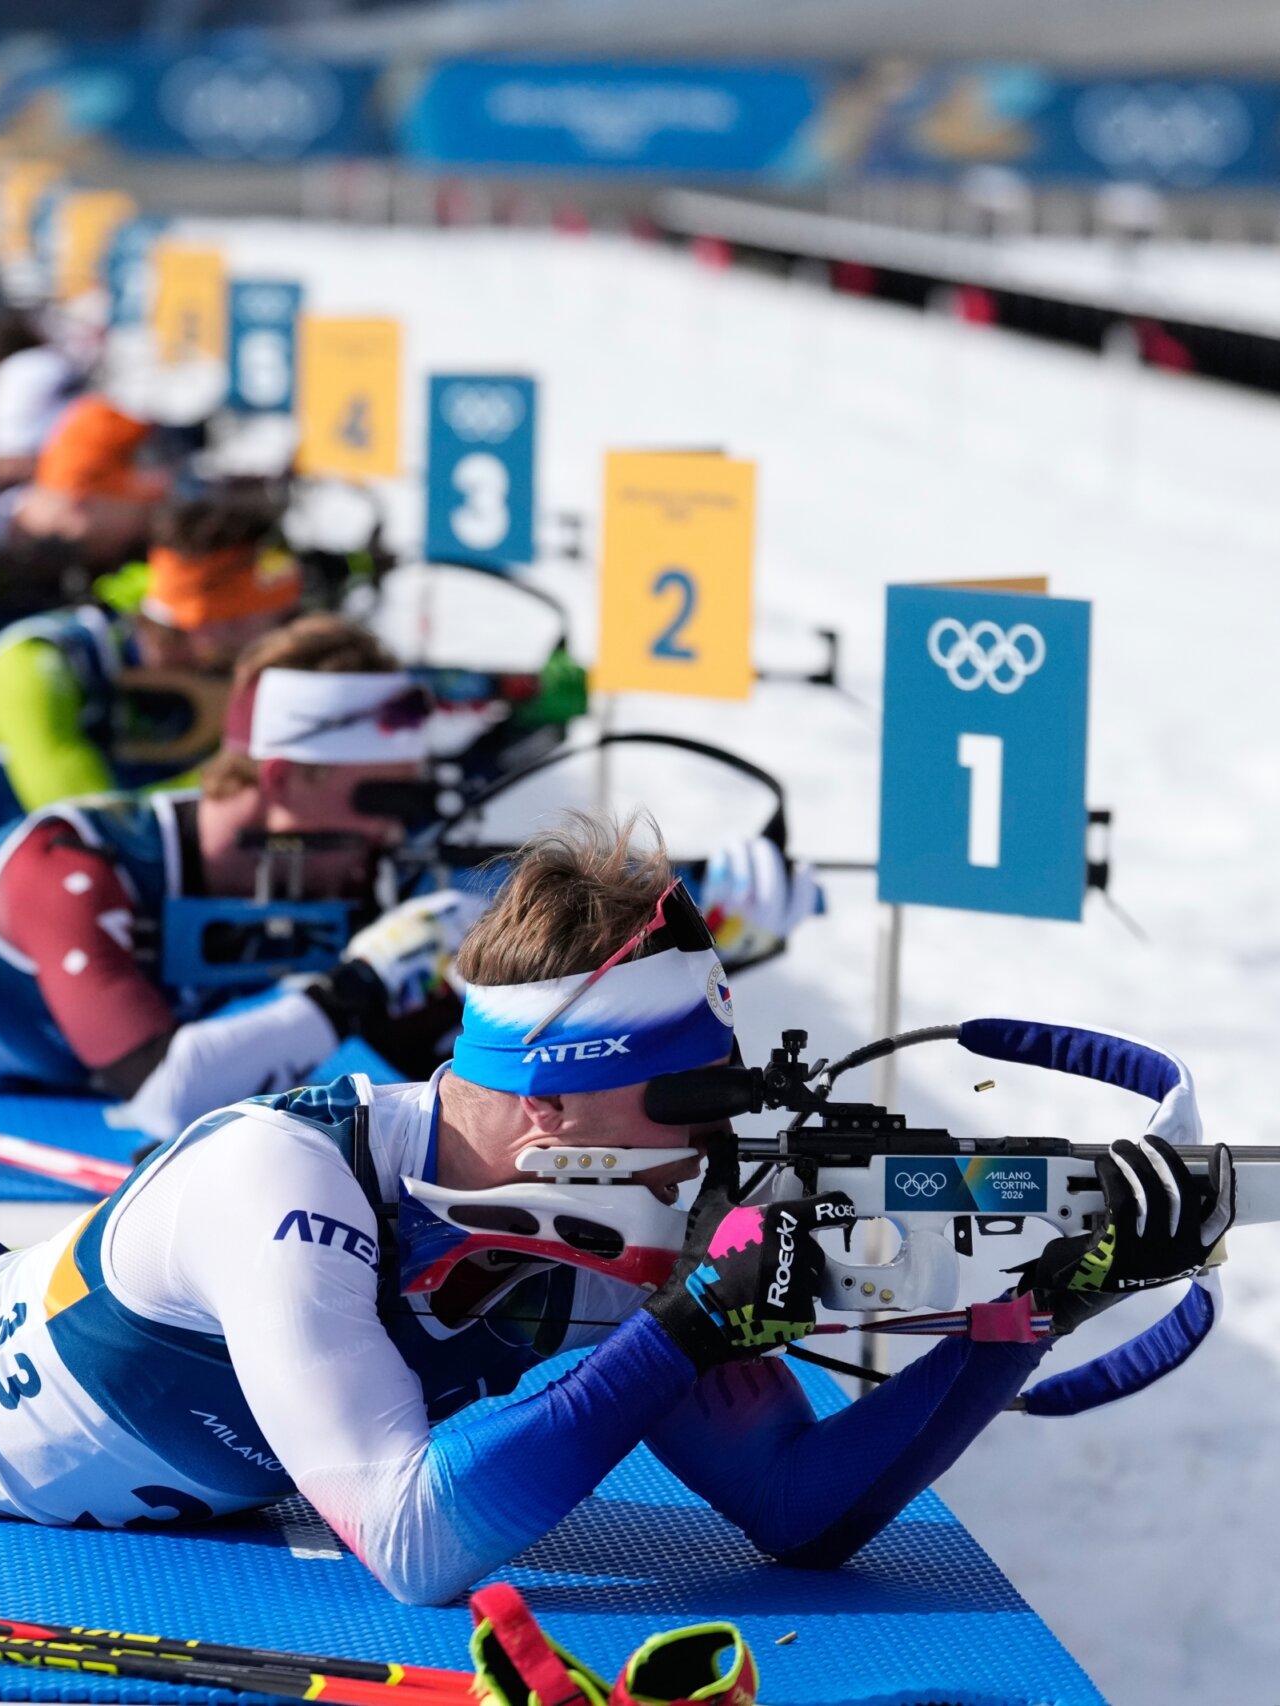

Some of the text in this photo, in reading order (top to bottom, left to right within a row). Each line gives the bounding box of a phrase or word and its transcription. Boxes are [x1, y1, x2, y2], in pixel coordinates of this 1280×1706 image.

[450, 451, 511, 551] 3
[652, 569, 696, 659] 2
[957, 732, 1004, 869] 1
[522, 1034, 632, 1063] ATEX
[985, 1171, 1031, 1180] MILANO
[992, 1181, 1040, 1190] CORTINA
[1001, 1191, 1024, 1199] 2026
[189, 1409, 284, 1471] MILANO
